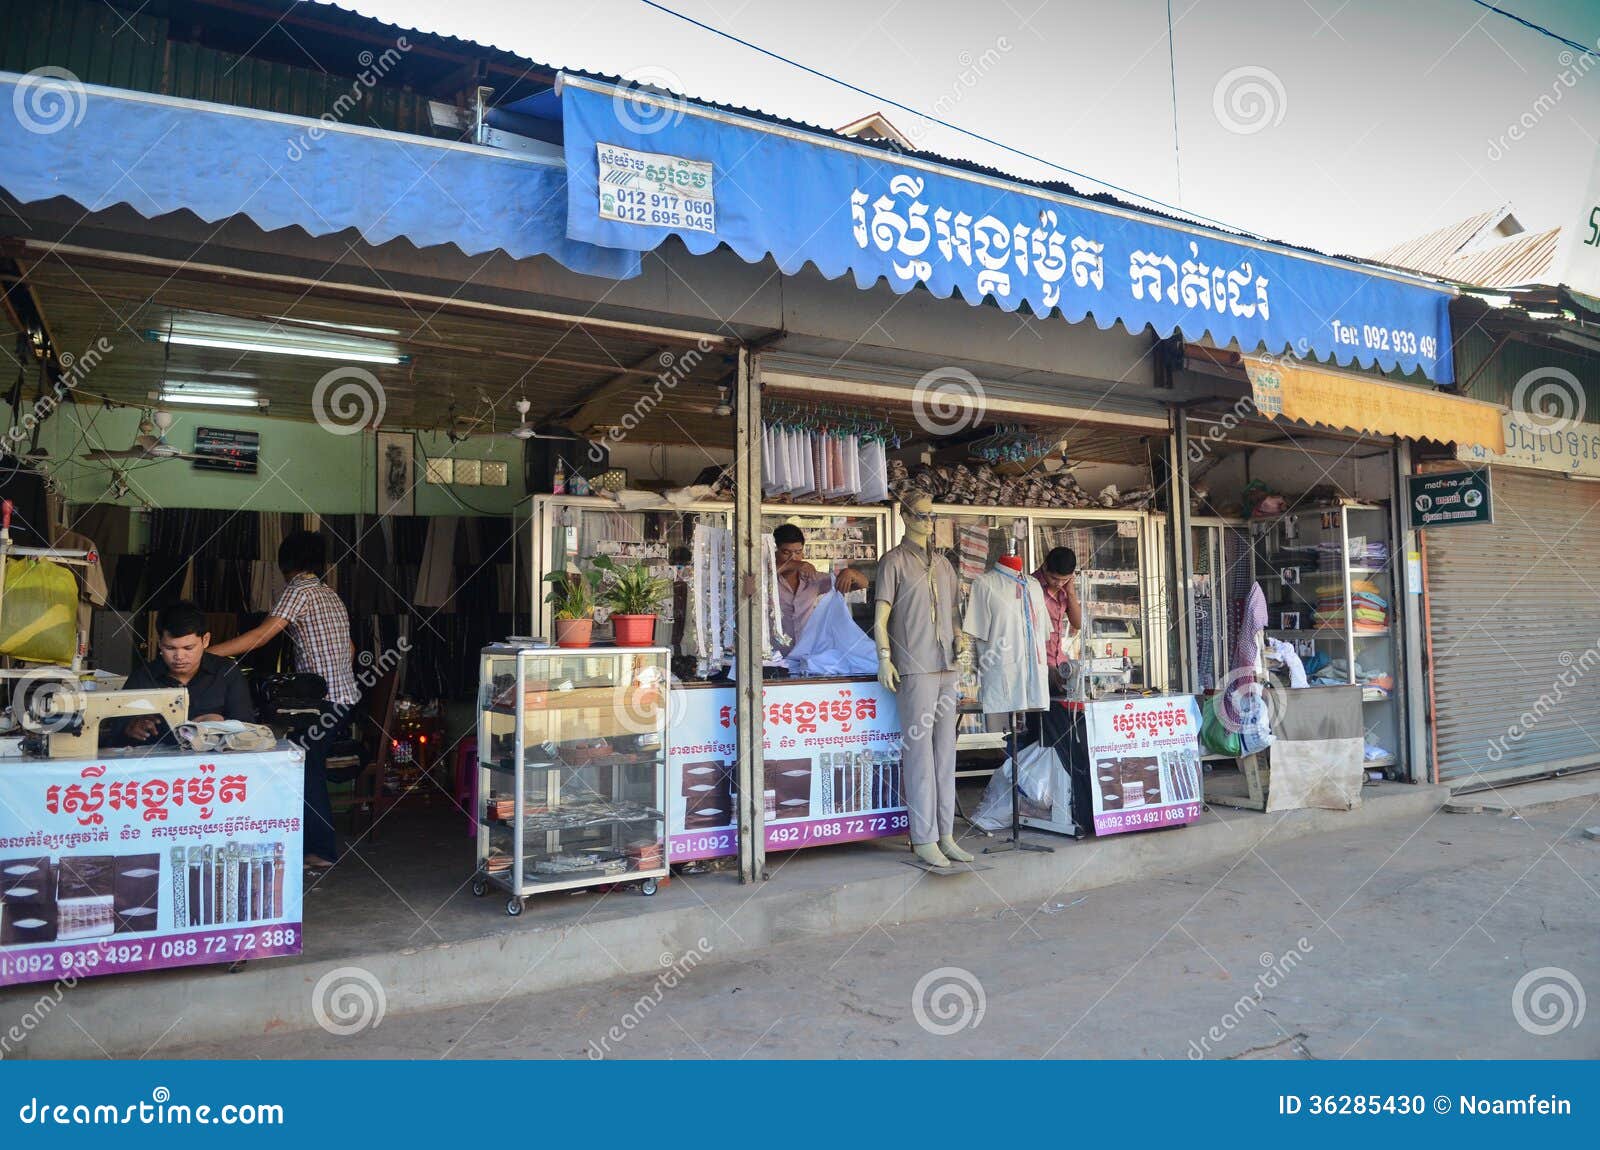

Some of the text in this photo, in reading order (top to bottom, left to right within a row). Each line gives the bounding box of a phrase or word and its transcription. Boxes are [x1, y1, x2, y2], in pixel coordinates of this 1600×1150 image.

[617, 188, 712, 215] 012 917 060
[617, 205, 713, 230] 012 695 045
[1363, 325, 1390, 350] 092
[1392, 330, 1417, 354] 933
[1125, 814, 1141, 825] 933
[1143, 812, 1159, 823] 492
[1166, 808, 1184, 820] 088
[120, 824, 141, 840] និង
[769, 828, 799, 842] 492
[813, 821, 841, 836] 088
[846, 820, 864, 834] 72
[868, 818, 887, 831] 72
[59, 949, 99, 969] 933
[105, 945, 142, 964] 492
[161, 939, 197, 958] 088
[203, 936, 227, 954] 72
[233, 934, 256, 951] 72
[262, 929, 295, 948] 388
